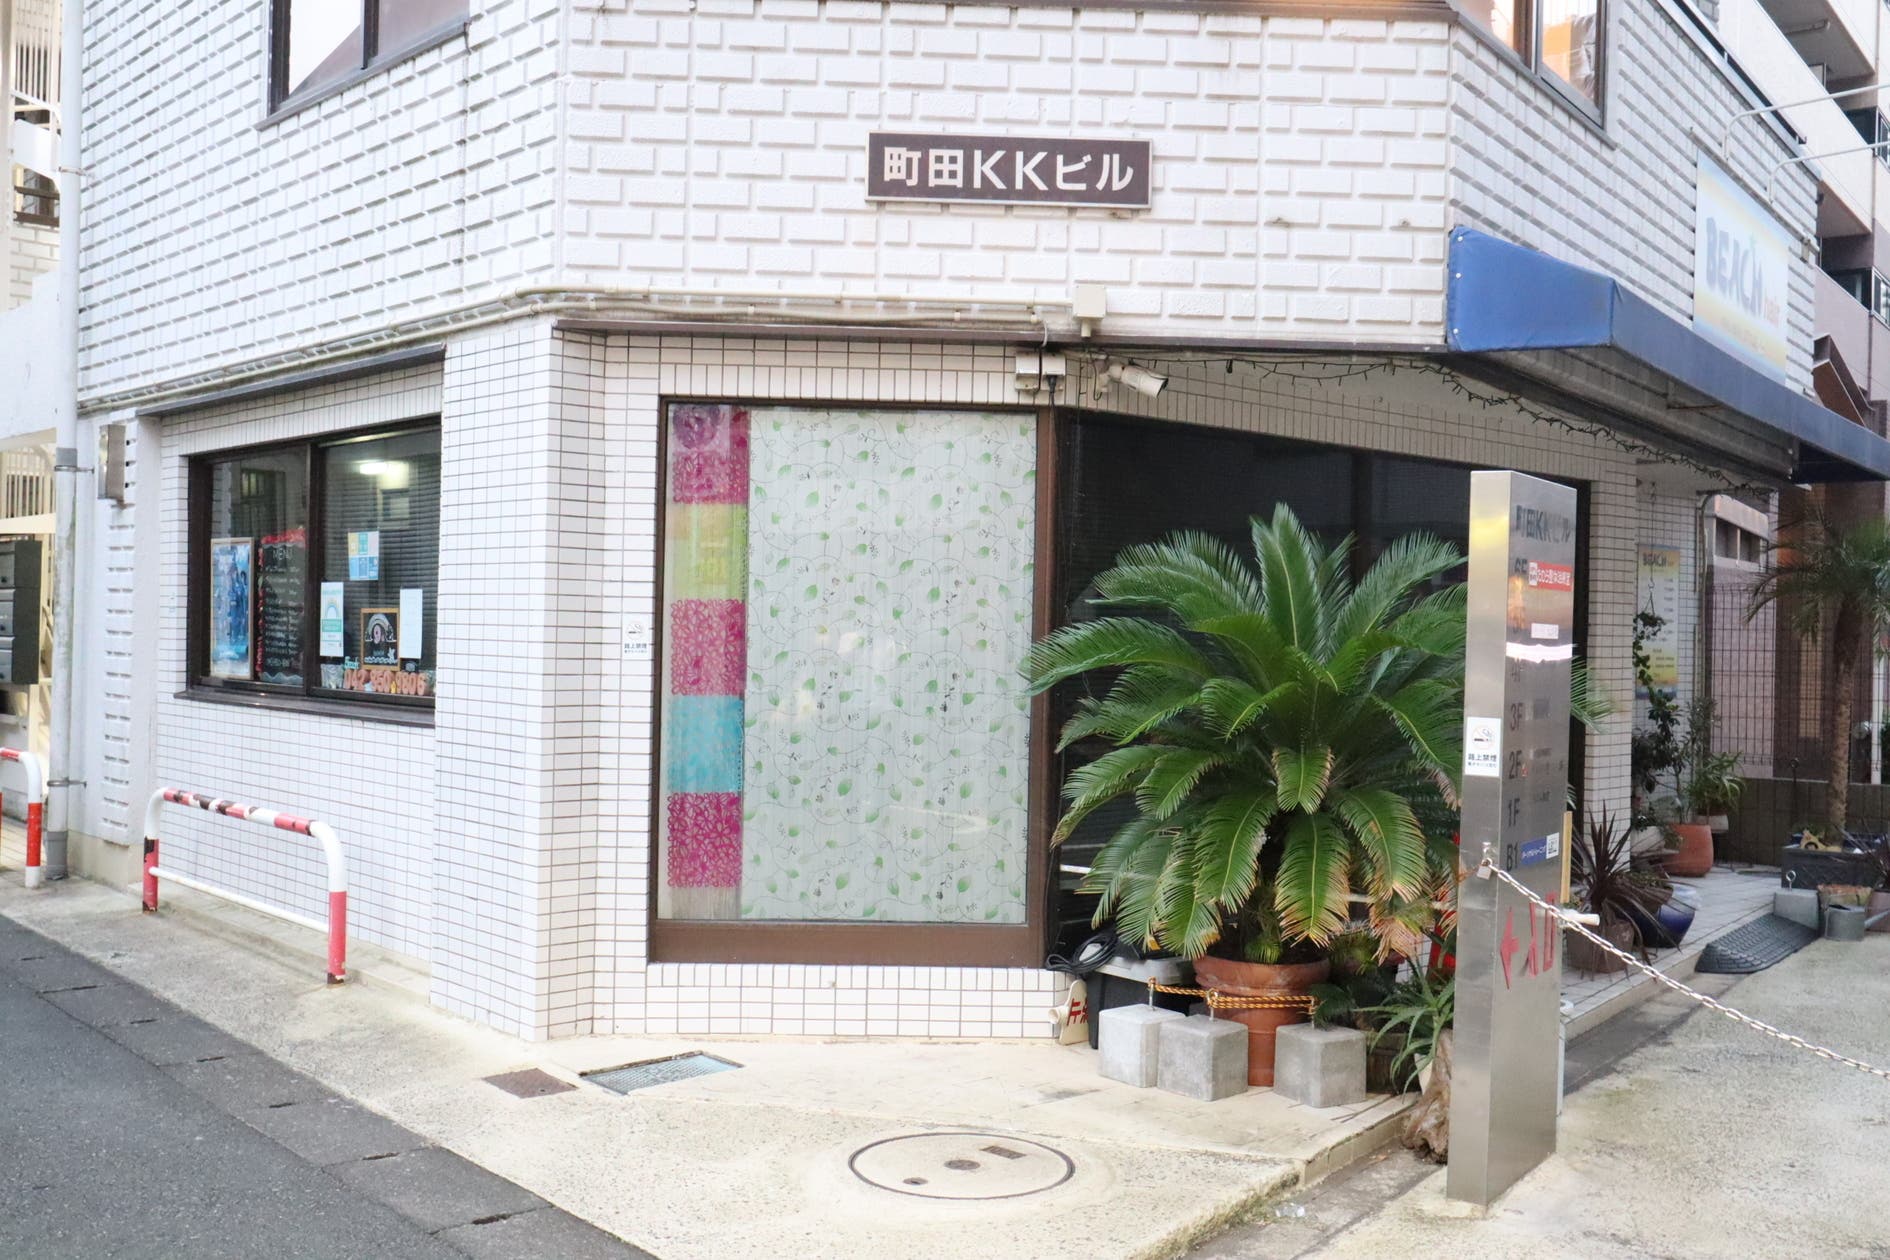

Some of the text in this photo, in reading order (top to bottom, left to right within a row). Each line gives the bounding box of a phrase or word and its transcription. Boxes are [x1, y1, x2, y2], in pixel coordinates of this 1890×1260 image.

[883, 146, 1134, 192] 町田KKビル
[1706, 216, 1763, 317] BEACH
[1510, 702, 1523, 732] 3F
[1467, 753, 1497, 762] 路上禁煙
[1508, 750, 1522, 780] 2F
[1508, 798, 1520, 828] 1F
[1505, 842, 1519, 872] B1
